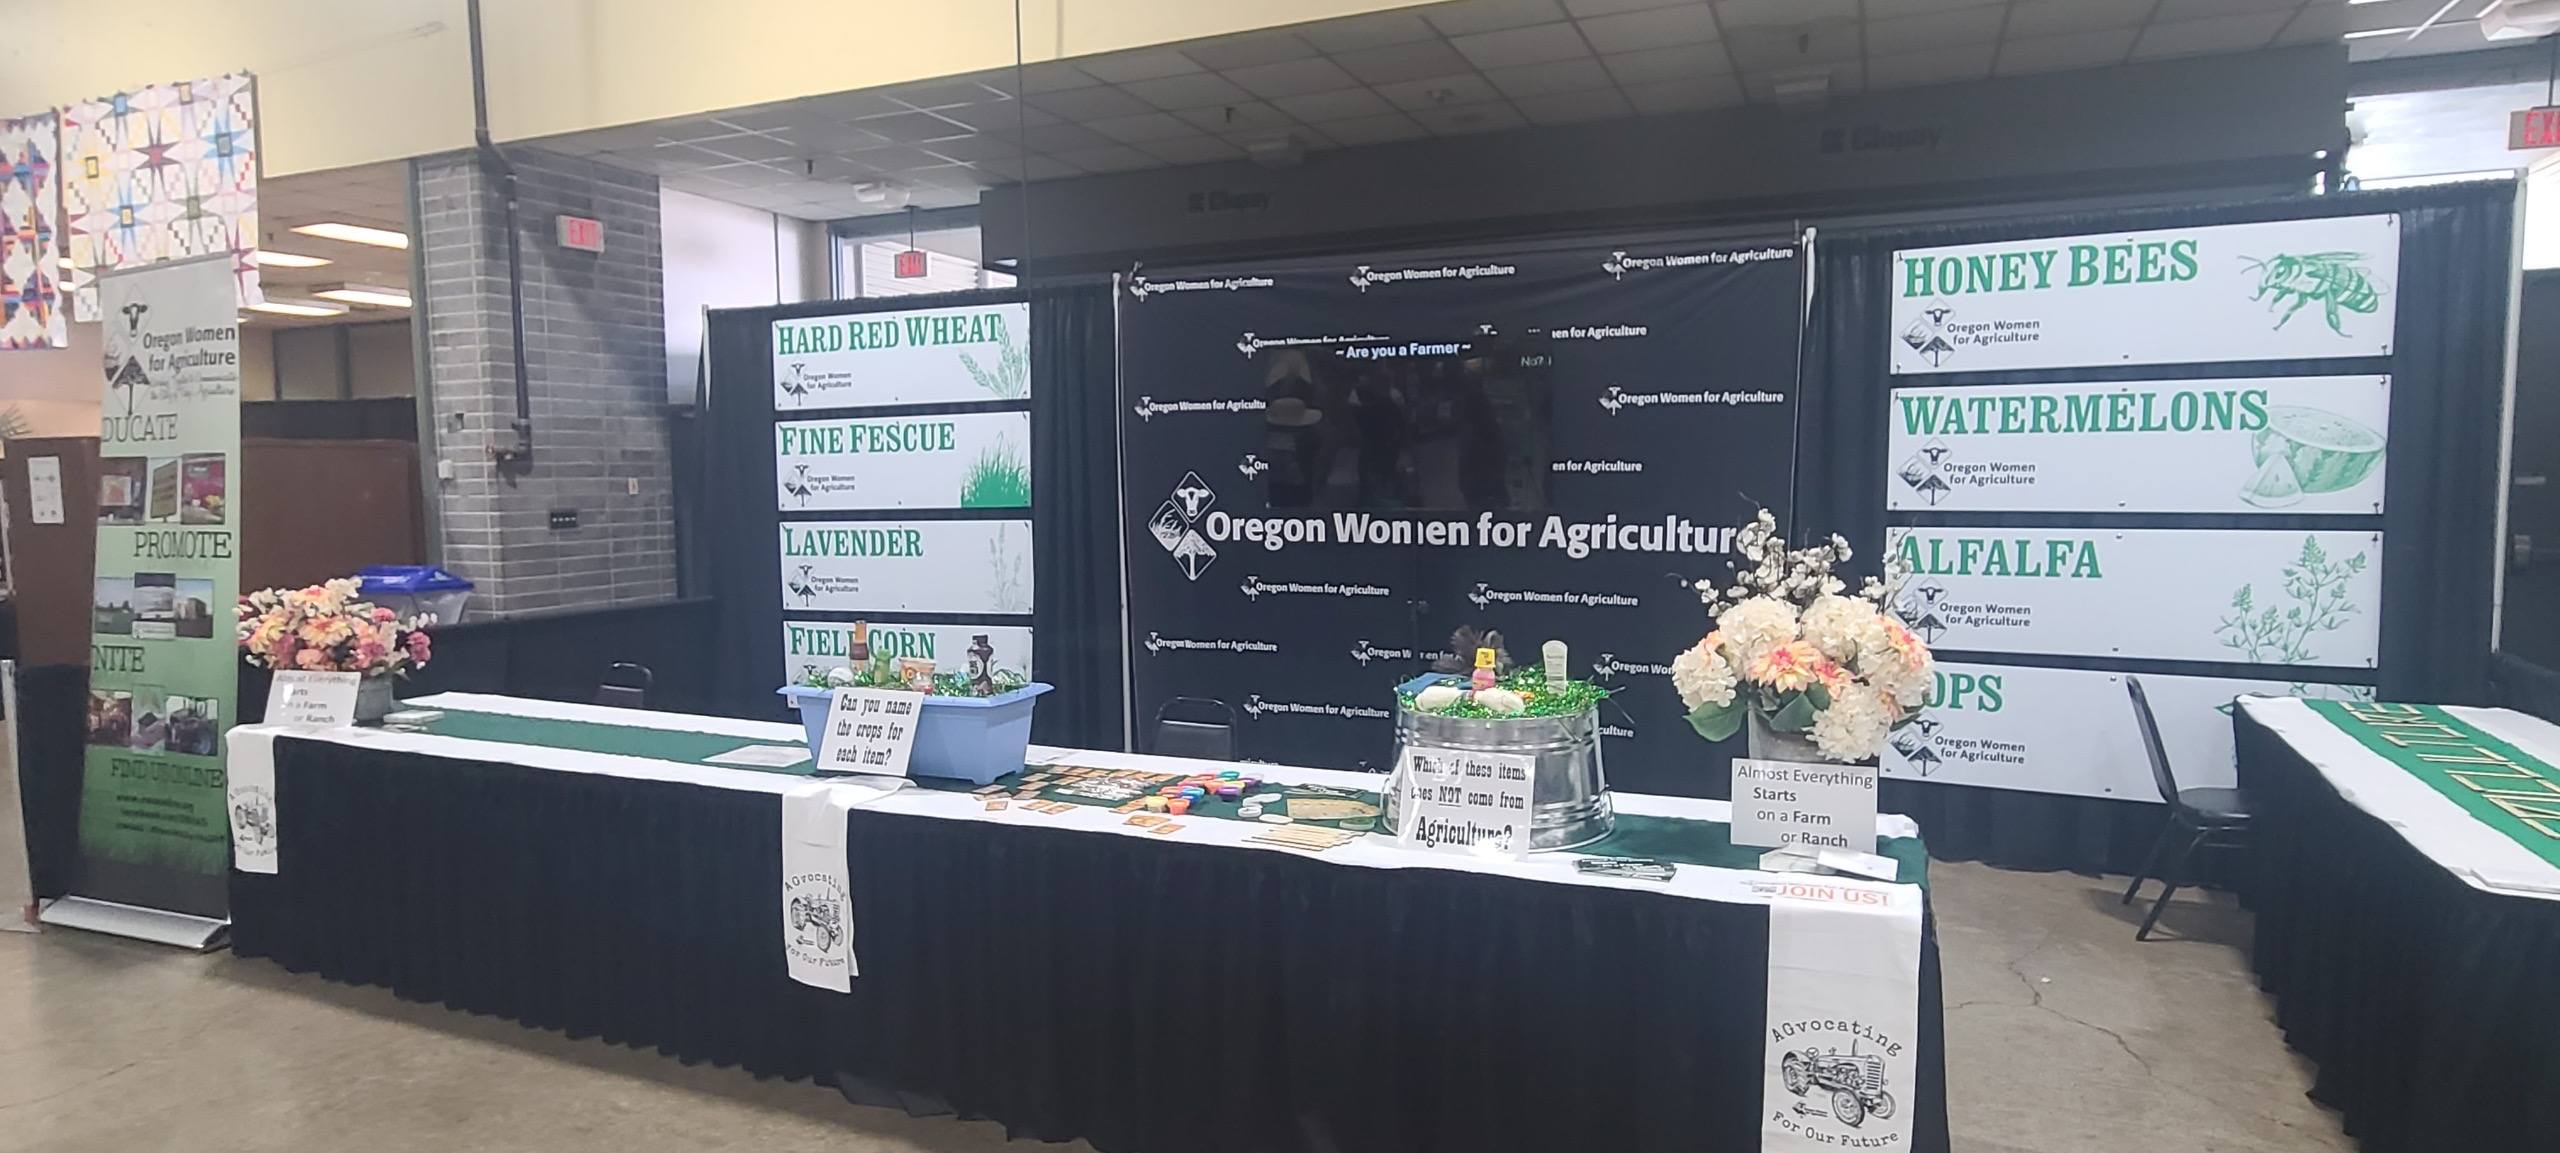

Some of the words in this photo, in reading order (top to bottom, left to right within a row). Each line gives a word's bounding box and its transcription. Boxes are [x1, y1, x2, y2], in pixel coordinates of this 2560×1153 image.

[1622, 259, 1663, 270] Oregon
[1665, 255, 1709, 266] Women
[1710, 252, 1727, 263] for
[1729, 248, 1793, 264] Agriculture
[1367, 271, 1402, 283] Oregon
[1403, 269, 1441, 279] Women
[1442, 267, 1457, 277] for
[1458, 265, 1515, 279] Agriculture
[1903, 250, 2057, 297] HONEY
[2067, 240, 2197, 287] BEES
[1144, 282, 1175, 293] Oregon
[1176, 281, 1209, 290] Women
[1210, 279, 1223, 288] for
[1225, 277, 1274, 290] Agriculture
[779, 325, 842, 355] HARD
[848, 321, 899, 350] RED
[905, 314, 1001, 346] WHEAT
[1570, 327, 1585, 338] for
[1587, 325, 1647, 340] Agriculture
[1947, 322, 1990, 334] Oregon
[1994, 320, 2040, 330] Women
[143, 332, 183, 352] Oregon
[186, 327, 236, 343] Women
[1953, 334, 1970, 344] for
[1973, 332, 2040, 345] Agriculture
[1346, 346, 1369, 358] Are
[1371, 347, 1396, 360] you
[1399, 347, 1407, 356] a
[1410, 343, 1459, 356] Farmer
[148, 354, 166, 371] for
[168, 348, 236, 374] Agriculture
[1149, 402, 1178, 414] Oregon
[1179, 401, 1211, 410] Women
[1212, 400, 1225, 410] for
[1227, 399, 1266, 412] Agricultu
[1618, 393, 1658, 406] Oregon
[1660, 392, 1702, 403] Women
[1703, 391, 1720, 402] for
[1722, 390, 1784, 405] Agriculture
[1900, 390, 2268, 436] WATERMELONS
[102, 413, 177, 442] DUCATE
[781, 427, 844, 455] FINE
[850, 423, 955, 453] FESCUE
[1567, 460, 1582, 471] for
[1583, 460, 1642, 474] Agriculture
[1944, 462, 1986, 474] Oregon
[1990, 462, 2036, 472] Women
[1949, 474, 1966, 484] for
[1969, 474, 2035, 486] Agriculture
[785, 528, 924, 557] LAVENDER
[1205, 511, 1326, 550] Oregon
[1333, 512, 1470, 546] Women
[1477, 511, 1532, 548] for
[1539, 514, 1738, 559] Agricultur
[133, 531, 232, 559] PROMOTE
[1900, 536, 2102, 578] ALFALFA
[1256, 582, 1287, 594] Oregon
[1289, 583, 1323, 593] Women
[1324, 583, 1338, 593] for
[1339, 585, 1389, 597] Agriculture
[1486, 590, 1522, 603] Oregon
[1524, 591, 1563, 602] Women
[1564, 592, 1579, 603] for
[1580, 593, 1638, 606] Agriculture
[1939, 603, 1982, 615] Oregon
[1985, 604, 2031, 615] Women
[1945, 614, 1962, 624] for
[1965, 616, 2031, 627] Agriculture
[868, 629, 936, 660] CORN
[1156, 639, 1184, 650] Oregon
[1185, 640, 1216, 649] Women
[1217, 639, 1230, 649] for
[1231, 641, 1278, 652] Agriculture
[1367, 647, 1400, 659] Oregon
[91, 645, 145, 672] NITE
[1611, 661, 1649, 674] Oregon
[1926, 671, 2003, 713] OPS
[840, 693, 857, 712] Can
[861, 697, 880, 716] you
[885, 701, 912, 715] name
[1259, 701, 1289, 713] Oregon
[1290, 703, 1324, 714] Women
[1325, 704, 1339, 715] for
[1340, 706, 1390, 718] Agriculture
[836, 720, 851, 736] the
[856, 724, 883, 743] crops
[888, 722, 904, 741] for
[1599, 725, 1634, 737] culture
[1935, 736, 1977, 749] Oregon
[1980, 740, 2026, 752] Women
[836, 747, 857, 763] each
[862, 747, 892, 767] item?
[1941, 747, 1958, 758] for
[1960, 750, 2025, 764] Agriculture
[1466, 760, 1492, 778] these
[1499, 763, 1526, 781] items
[1737, 766, 1788, 781] Almost
[1793, 769, 1873, 789] Everything
[1411, 787, 1433, 801] es
[1439, 786, 1462, 804] NOT
[1468, 791, 1494, 807] come
[1500, 791, 1524, 810] from
[1753, 787, 1797, 802] Starts
[1757, 809, 1775, 821] on
[1780, 811, 1788, 822] a
[1793, 811, 1831, 825] Farm
[1781, 834, 1797, 844] or
[1801, 832, 1848, 848] Ranch
[1777, 885, 1835, 900] JOIN
[1843, 889, 1889, 907] US!
[1772, 1019, 1903, 1057] AGvocating
[1772, 1111, 1801, 1132] For
[1805, 1126, 1836, 1144] Our
[1841, 1132, 1899, 1148] Future
